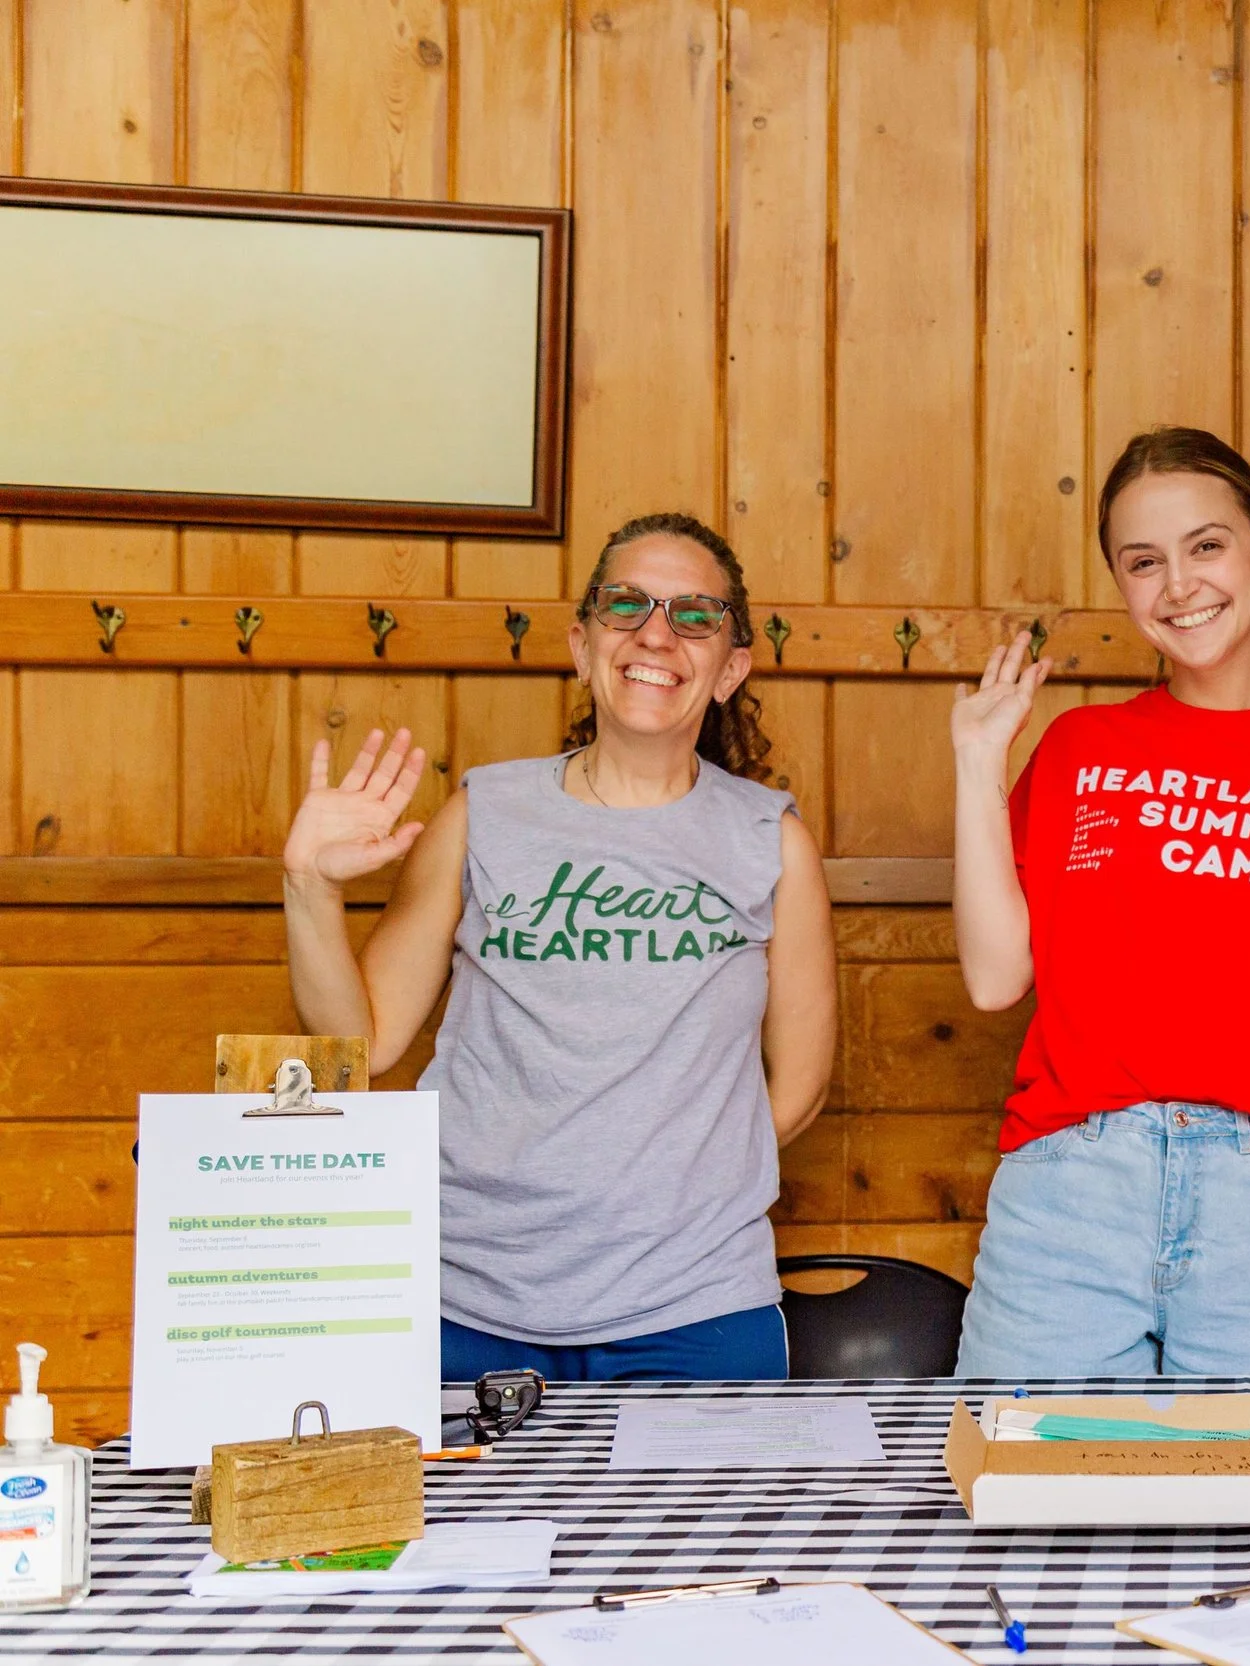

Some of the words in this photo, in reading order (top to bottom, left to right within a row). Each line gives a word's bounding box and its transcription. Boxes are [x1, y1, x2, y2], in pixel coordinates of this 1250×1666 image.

[1074, 815, 1119, 832] community
[529, 861, 736, 938] Heart
[480, 926, 748, 962] HEARTLAN
[198, 1154, 265, 1172] SAVE
[270, 1153, 317, 1170] THE
[322, 1152, 386, 1169] DATE
[236, 1174, 275, 1184] Heartland
[275, 1174, 287, 1183] for
[168, 1217, 209, 1232] night
[211, 1217, 257, 1229] under
[259, 1216, 285, 1227] the
[287, 1215, 328, 1227] stars
[167, 1273, 229, 1285] autumn
[231, 1269, 319, 1283] adventures
[166, 1327, 198, 1341] disc
[201, 1326, 233, 1342] golf
[235, 1323, 327, 1338] tournament
